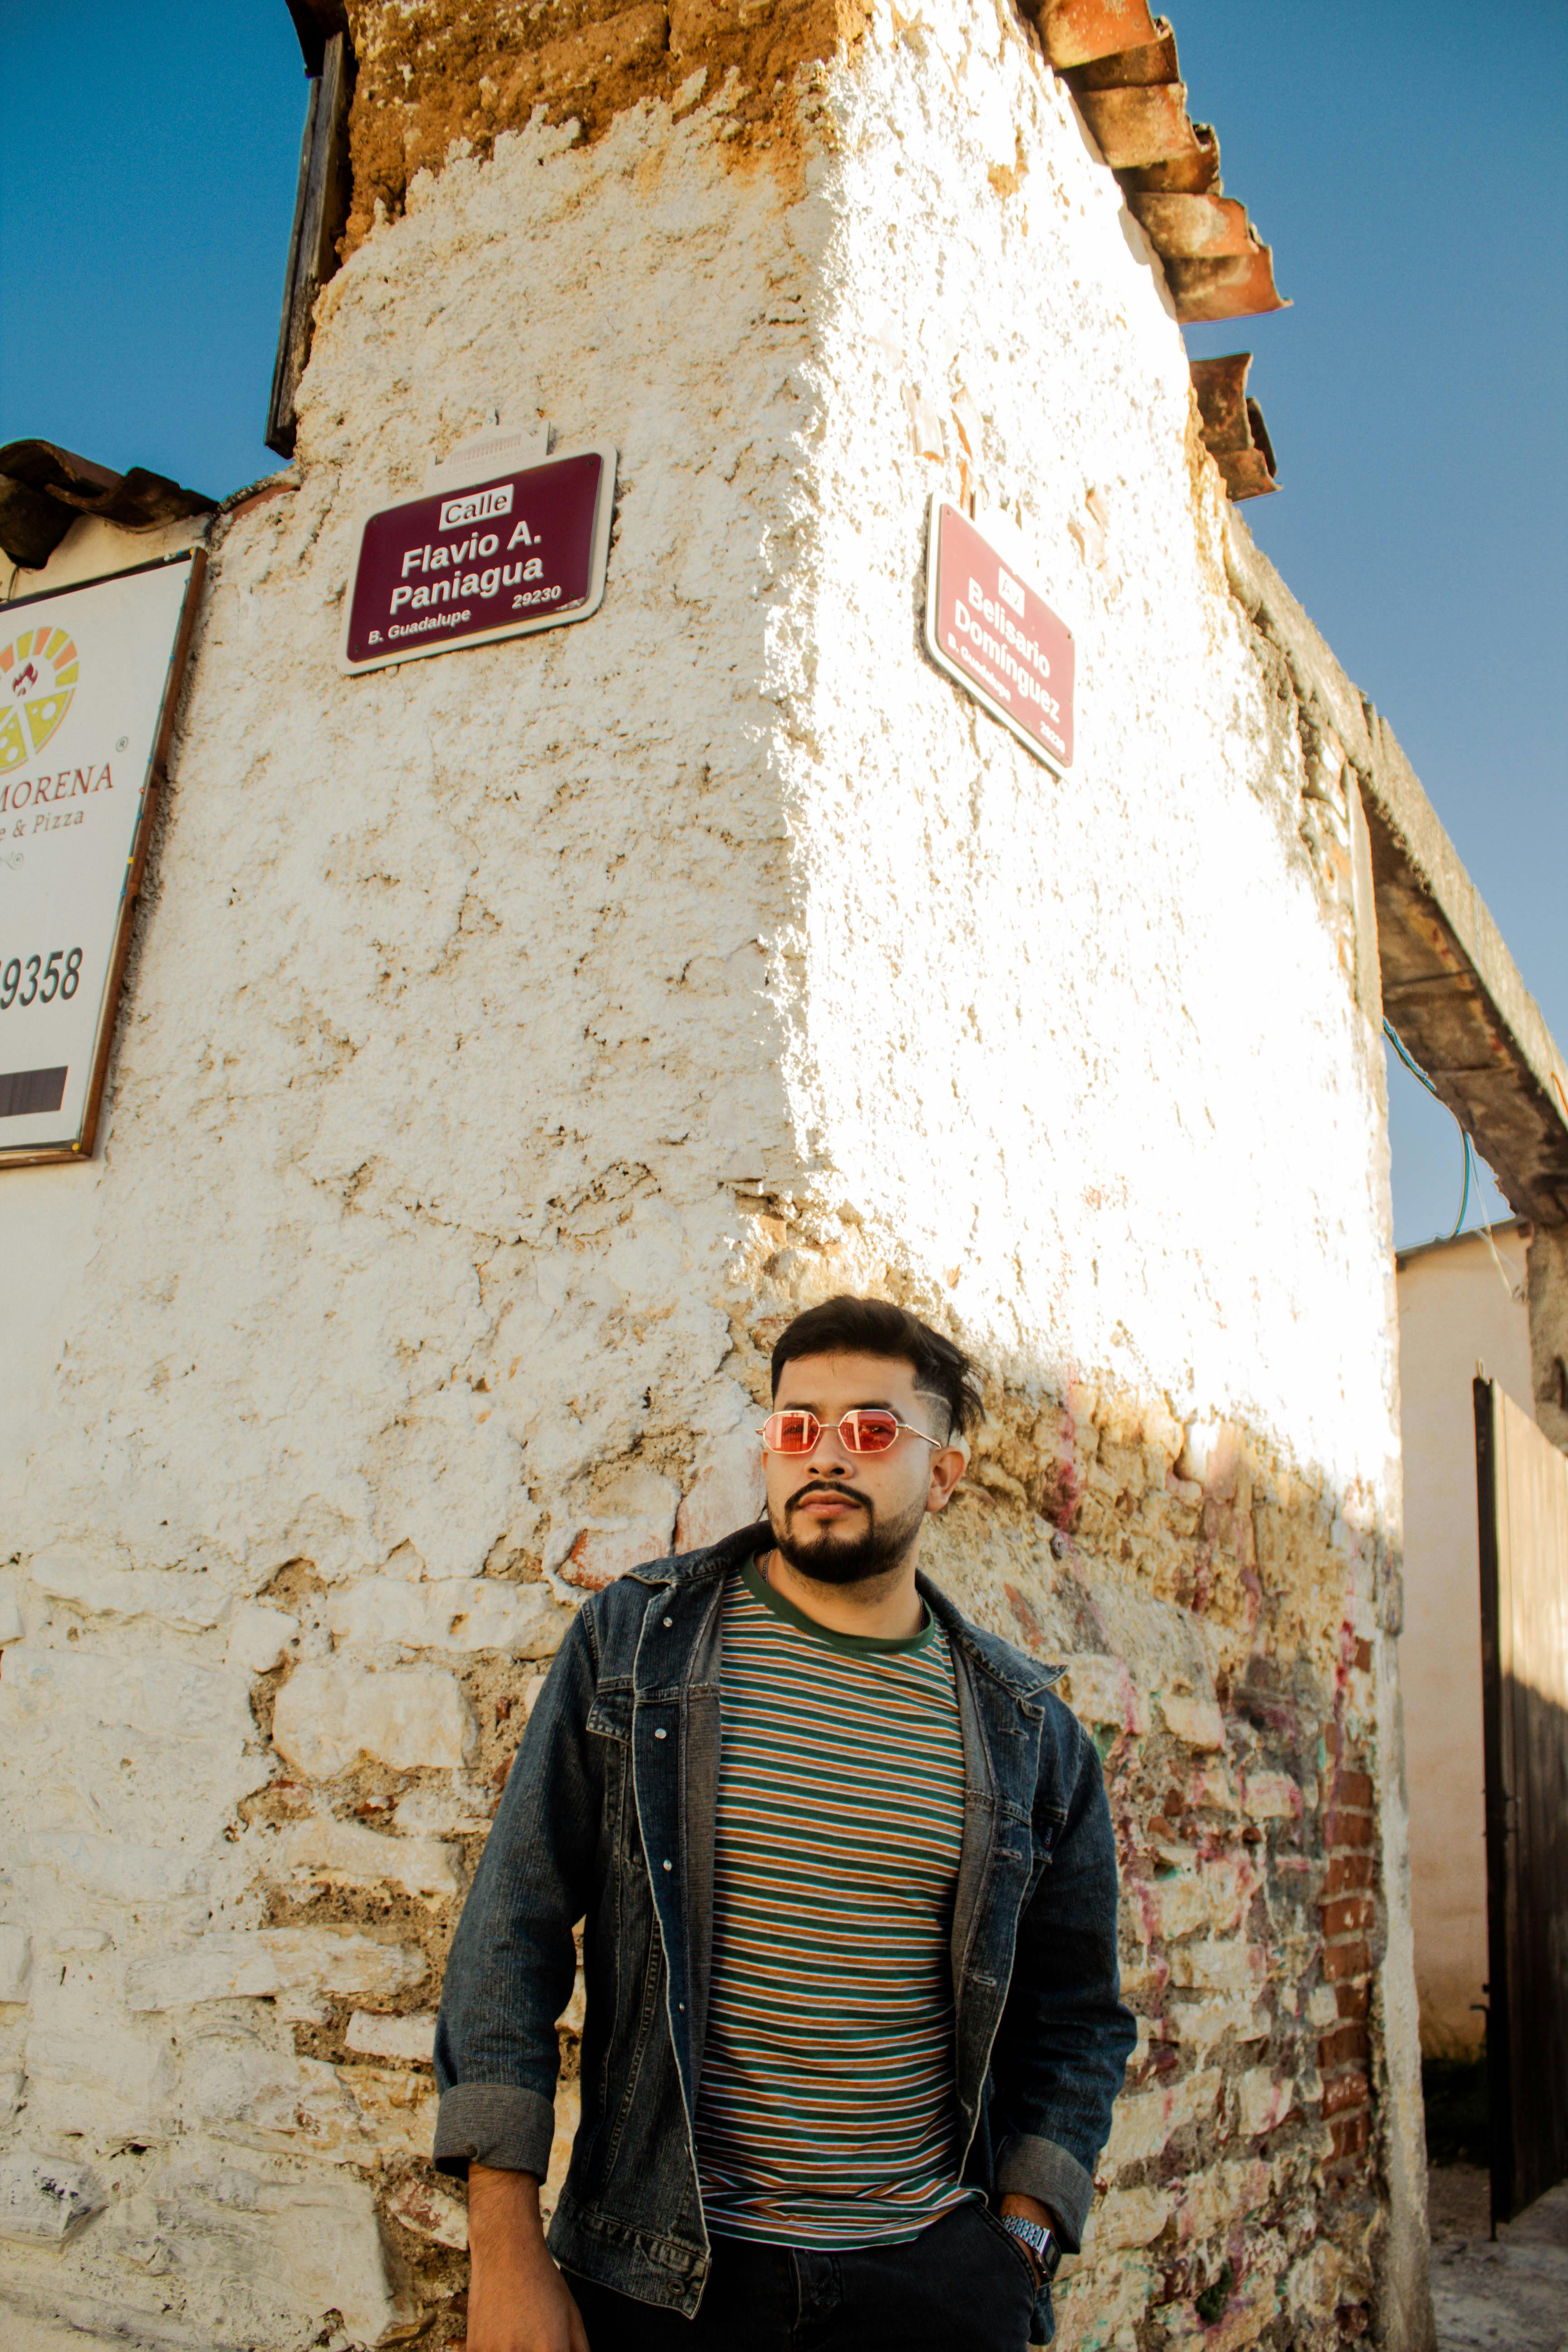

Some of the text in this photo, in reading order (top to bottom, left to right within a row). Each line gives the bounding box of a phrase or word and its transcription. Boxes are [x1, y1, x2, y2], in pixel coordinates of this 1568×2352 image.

[445, 493, 508, 524] Calle
[401, 520, 542, 578] Flavio A.
[368, 585, 562, 645] B. Guadalupe 29230
[390, 557, 544, 615] Paniagua
[968, 576, 1051, 678] Belisario
[955, 598, 1060, 724] Domínguez
[13, 820, 28, 838] &
[32, 809, 84, 834] Pizza
[0, 947, 83, 1010] 9358
